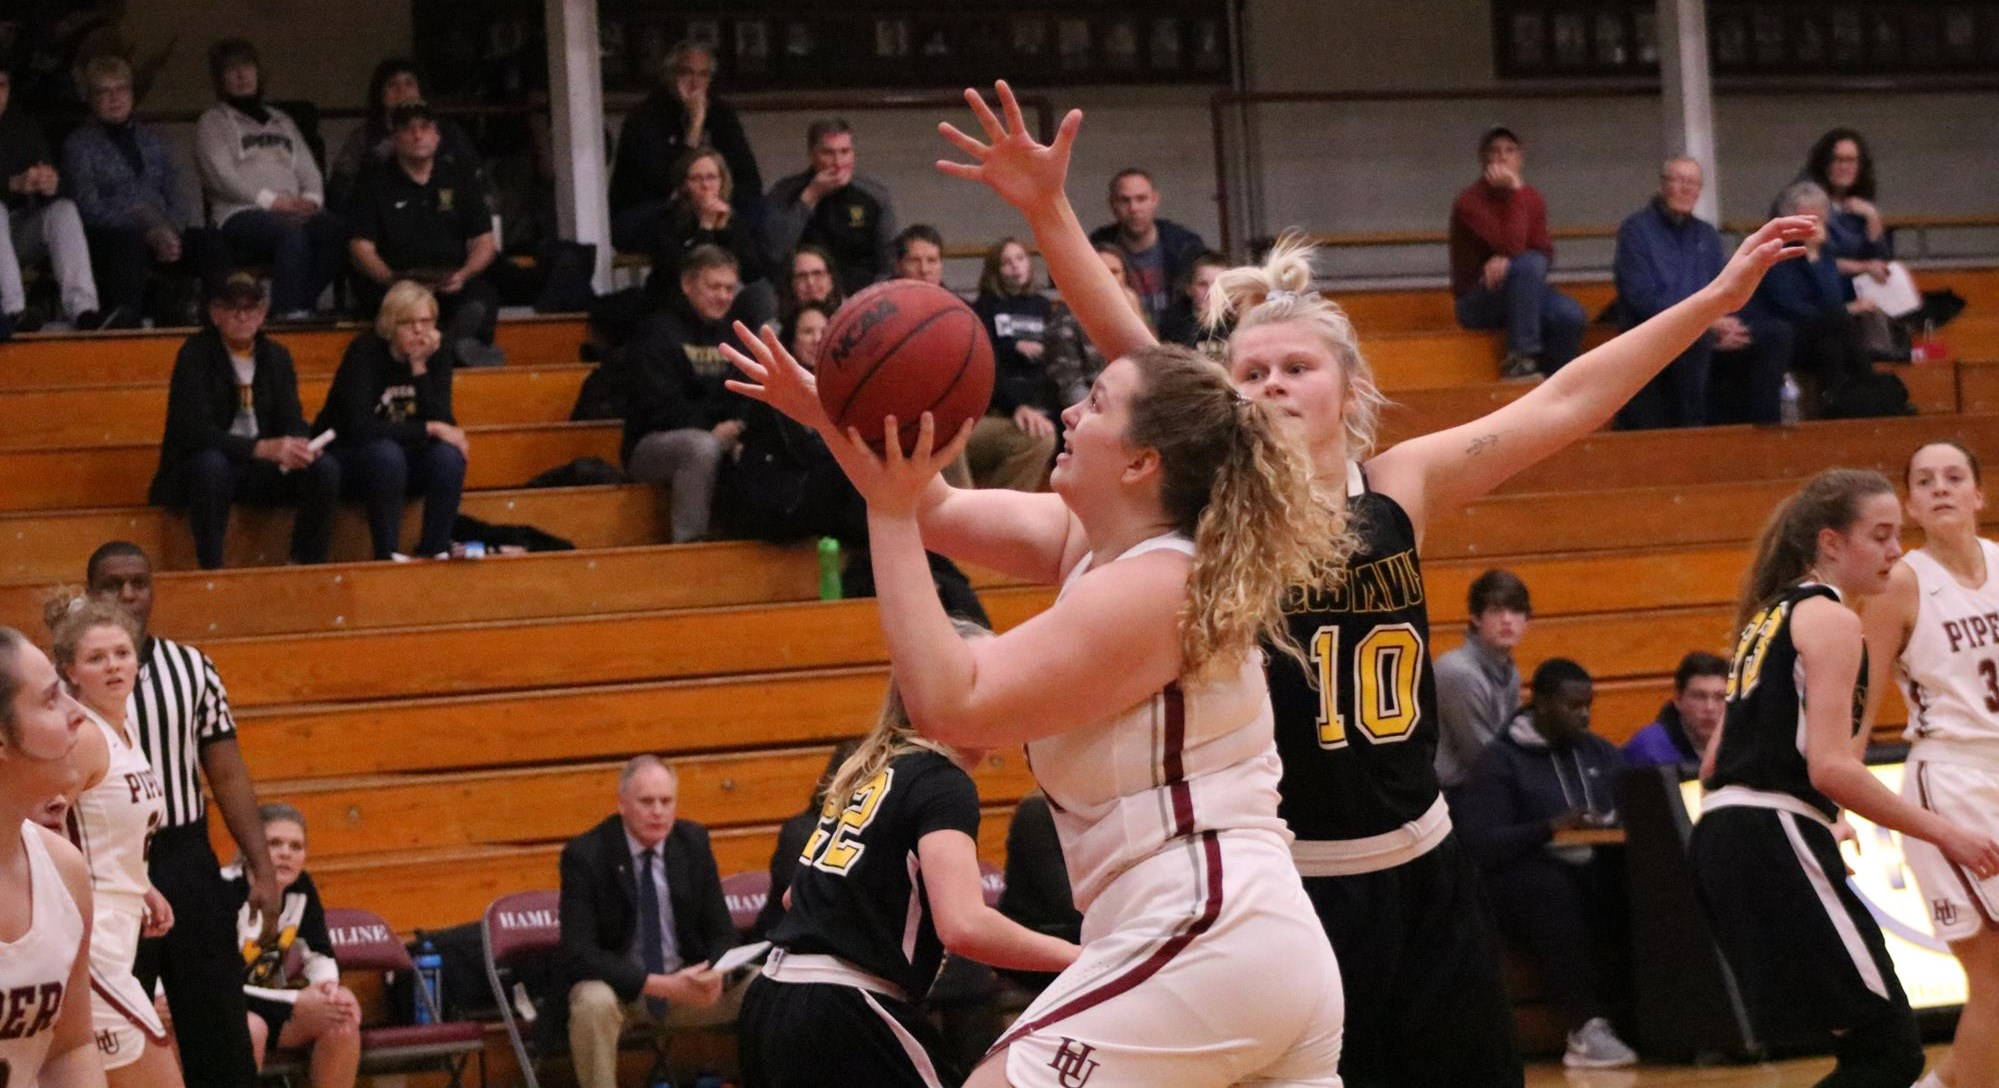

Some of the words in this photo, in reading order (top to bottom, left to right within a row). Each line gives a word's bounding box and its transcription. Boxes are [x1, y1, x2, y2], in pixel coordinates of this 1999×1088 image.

[832, 300, 898, 370] NCAA
[1310, 622, 1424, 749] 10
[799, 767, 894, 876] 22
[0, 981, 63, 1039] ER
[1046, 1036, 1101, 1088] HU
